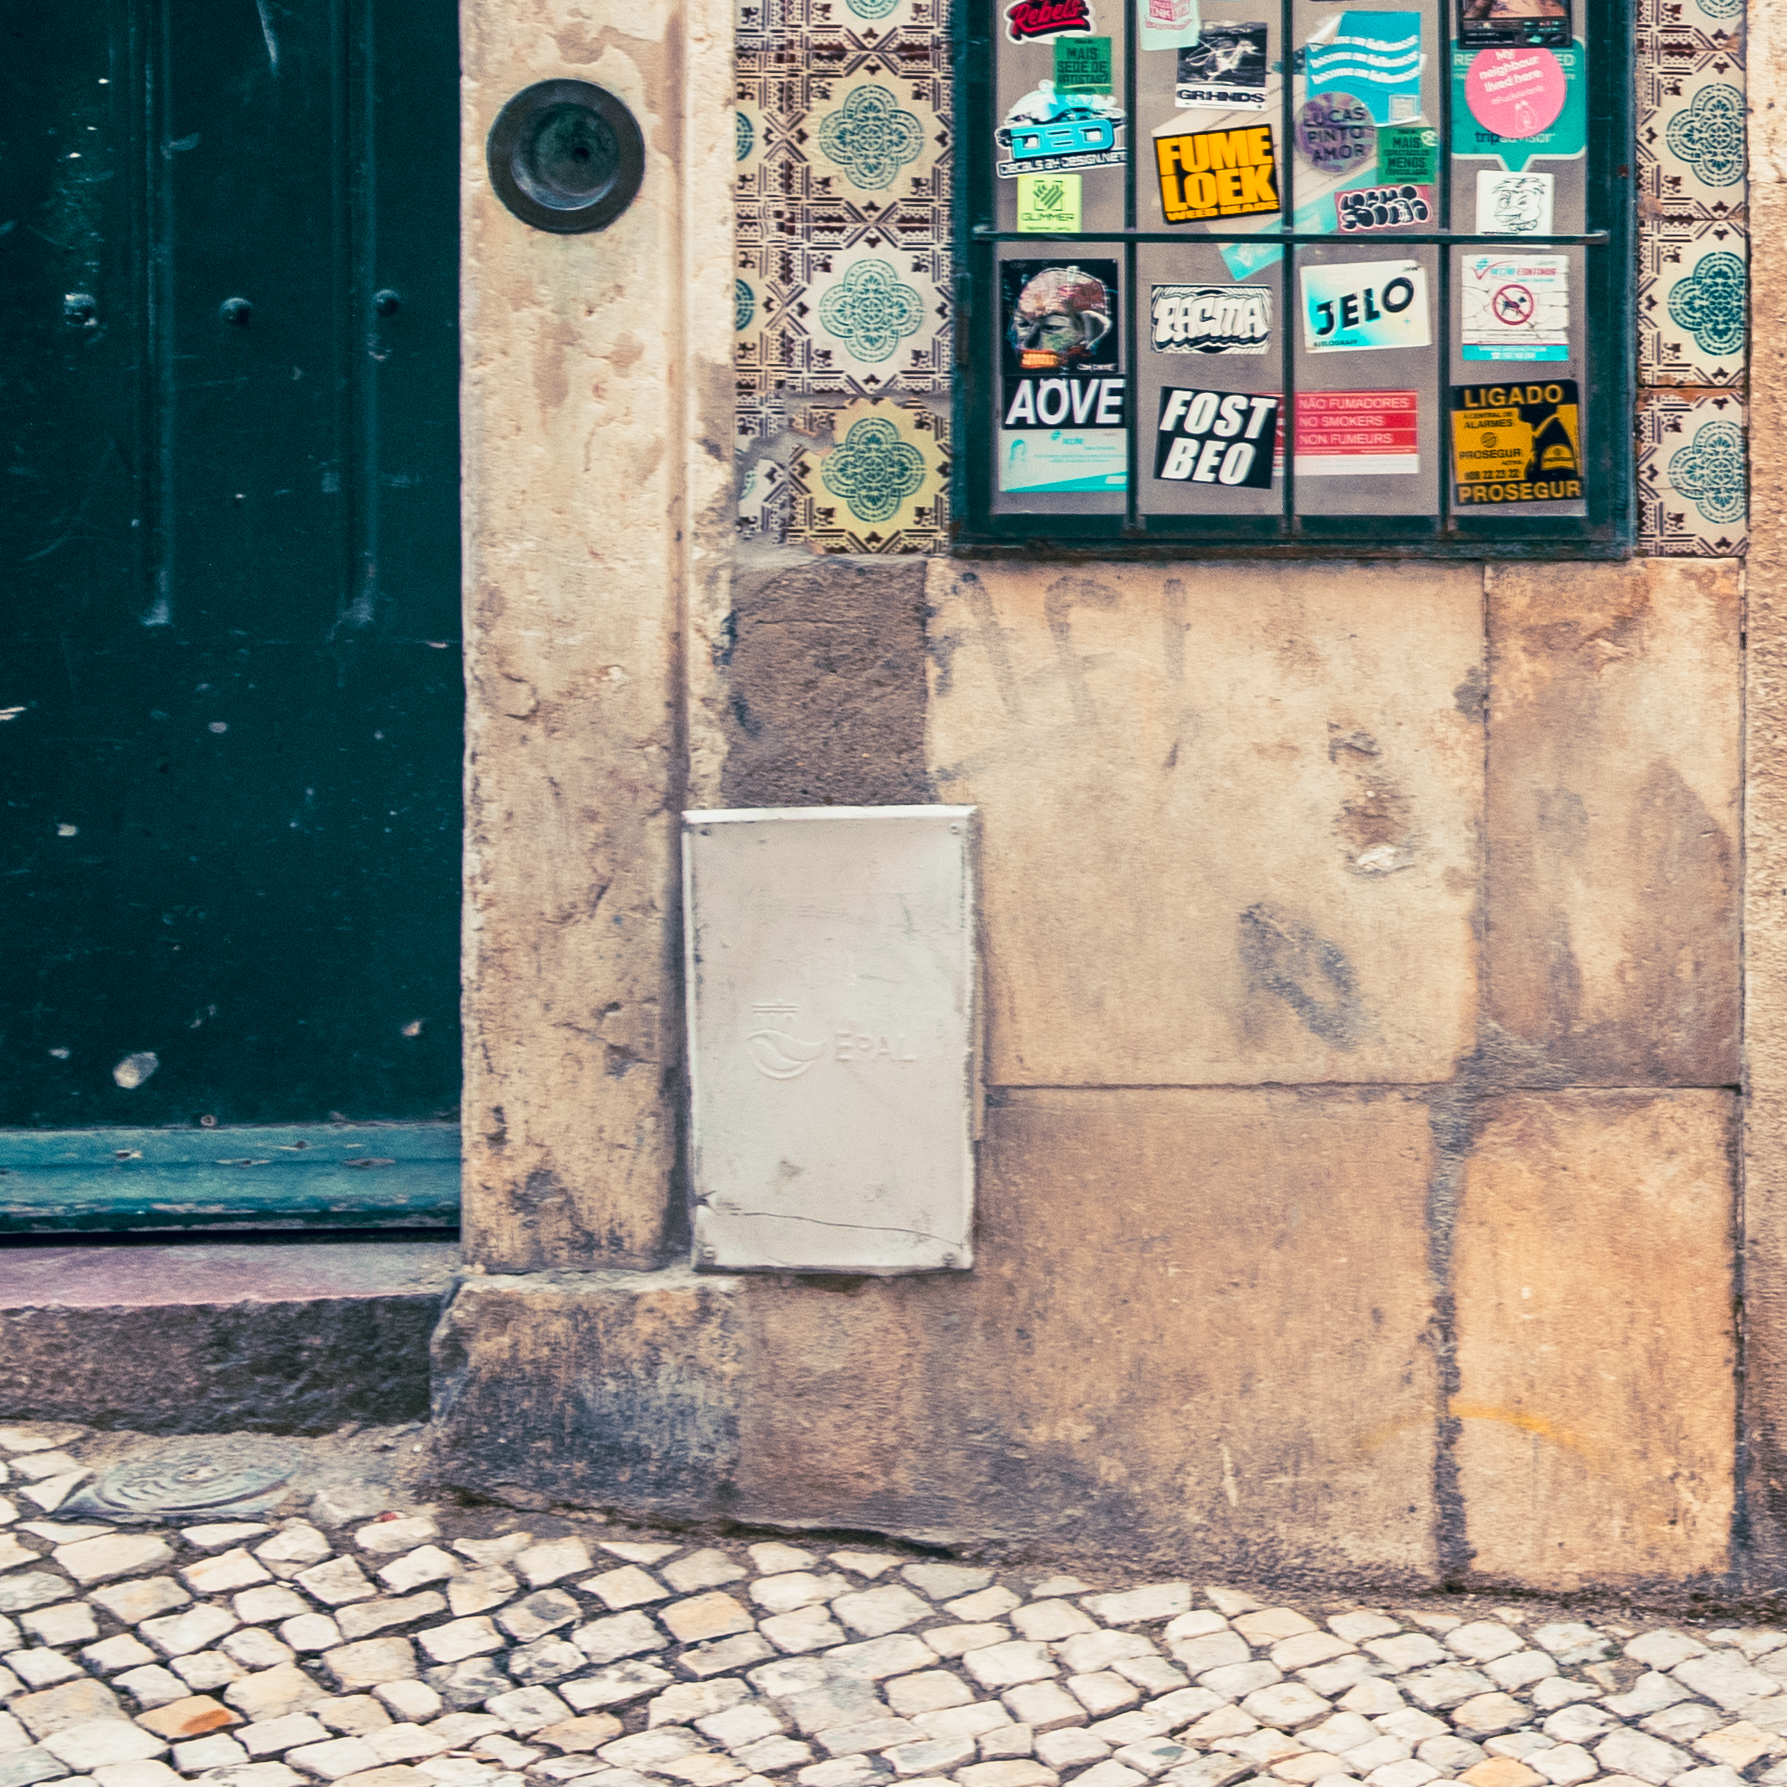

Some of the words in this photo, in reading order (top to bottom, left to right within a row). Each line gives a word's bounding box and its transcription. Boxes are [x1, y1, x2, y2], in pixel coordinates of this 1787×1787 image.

[1066, 47, 1099, 61] MAIS
[1058, 61, 1089, 74] SEDE
[1479, 56, 1541, 80] neighbour
[1483, 75, 1515, 92] lived
[1513, 69, 1544, 84] here
[1304, 106, 1366, 127] LUCAS
[1307, 125, 1364, 144] PINTO
[1392, 136, 1422, 149] MAIS
[1156, 126, 1273, 176] FUME
[1311, 144, 1366, 163] AMOR
[1387, 157, 1426, 168] MENOS
[1161, 164, 1279, 213] LOEK
[1021, 212, 1075, 222] GLIMMER
[1167, 207, 1219, 221] WEED
[1220, 199, 1280, 216] HEADS
[1315, 276, 1415, 336] JELO
[1299, 396, 1326, 410] NÃO
[1329, 396, 1411, 410] FUMADORES
[1464, 384, 1564, 408] LIGADO
[1159, 389, 1278, 439] FOST
[1299, 415, 1318, 427] NO
[1320, 415, 1384, 428] SMOKERS
[1464, 418, 1513, 429] ALARMES
[1299, 433, 1328, 445] NON
[1330, 432, 1393, 445] FUMEURS
[1160, 437, 1256, 485] BEO
[1459, 448, 1522, 460] PROSEGUR
[1457, 480, 1581, 503] PROSEGUR
